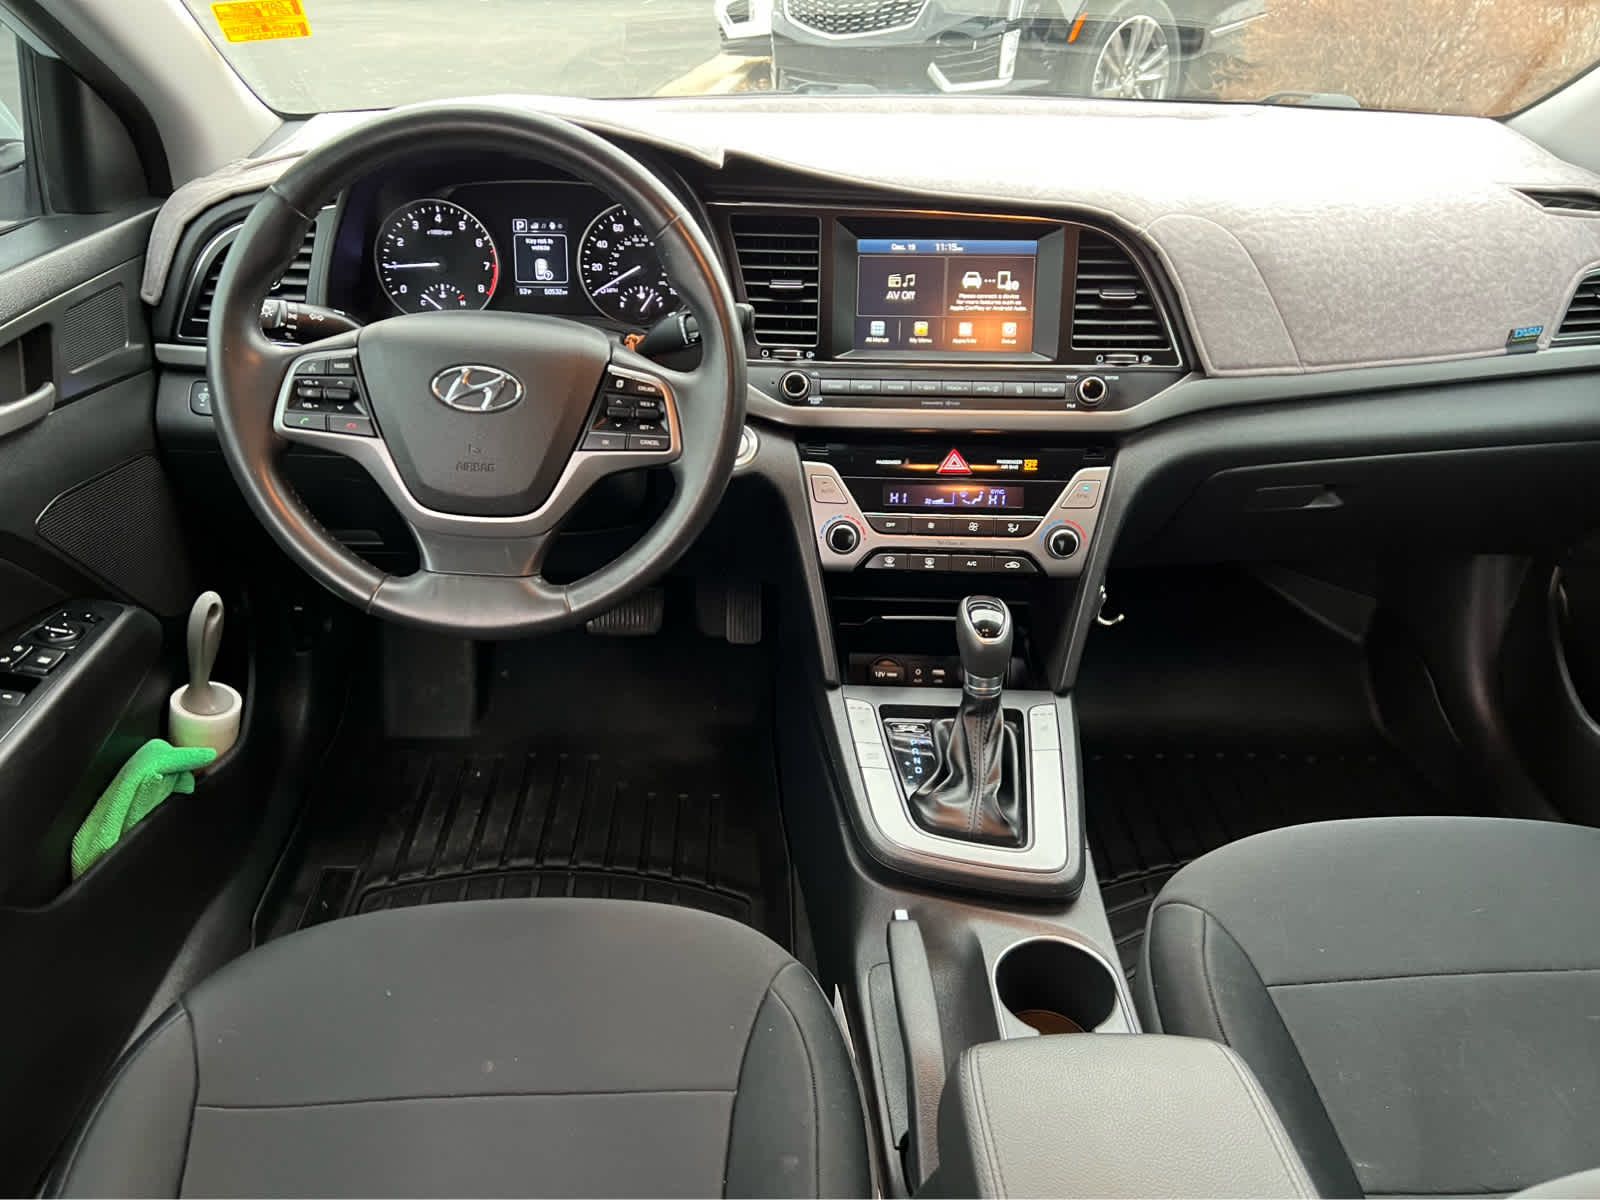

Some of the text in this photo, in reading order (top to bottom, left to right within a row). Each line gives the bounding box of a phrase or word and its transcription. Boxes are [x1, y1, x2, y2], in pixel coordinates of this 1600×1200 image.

[434, 214, 442, 223] 4
[411, 220, 420, 230] 3
[458, 221, 467, 230] 5
[516, 220, 525, 231] P
[396, 237, 405, 247] 2
[475, 238, 484, 248] 6
[596, 240, 608, 248] 40
[482, 261, 490, 270] 7
[591, 263, 603, 272] 20
[399, 284, 408, 294] 0
[477, 284, 486, 294] 8
[886, 291, 916, 300] AV Off
[639, 439, 661, 447] CANCEL
[456, 462, 496, 473] AIRBAG
